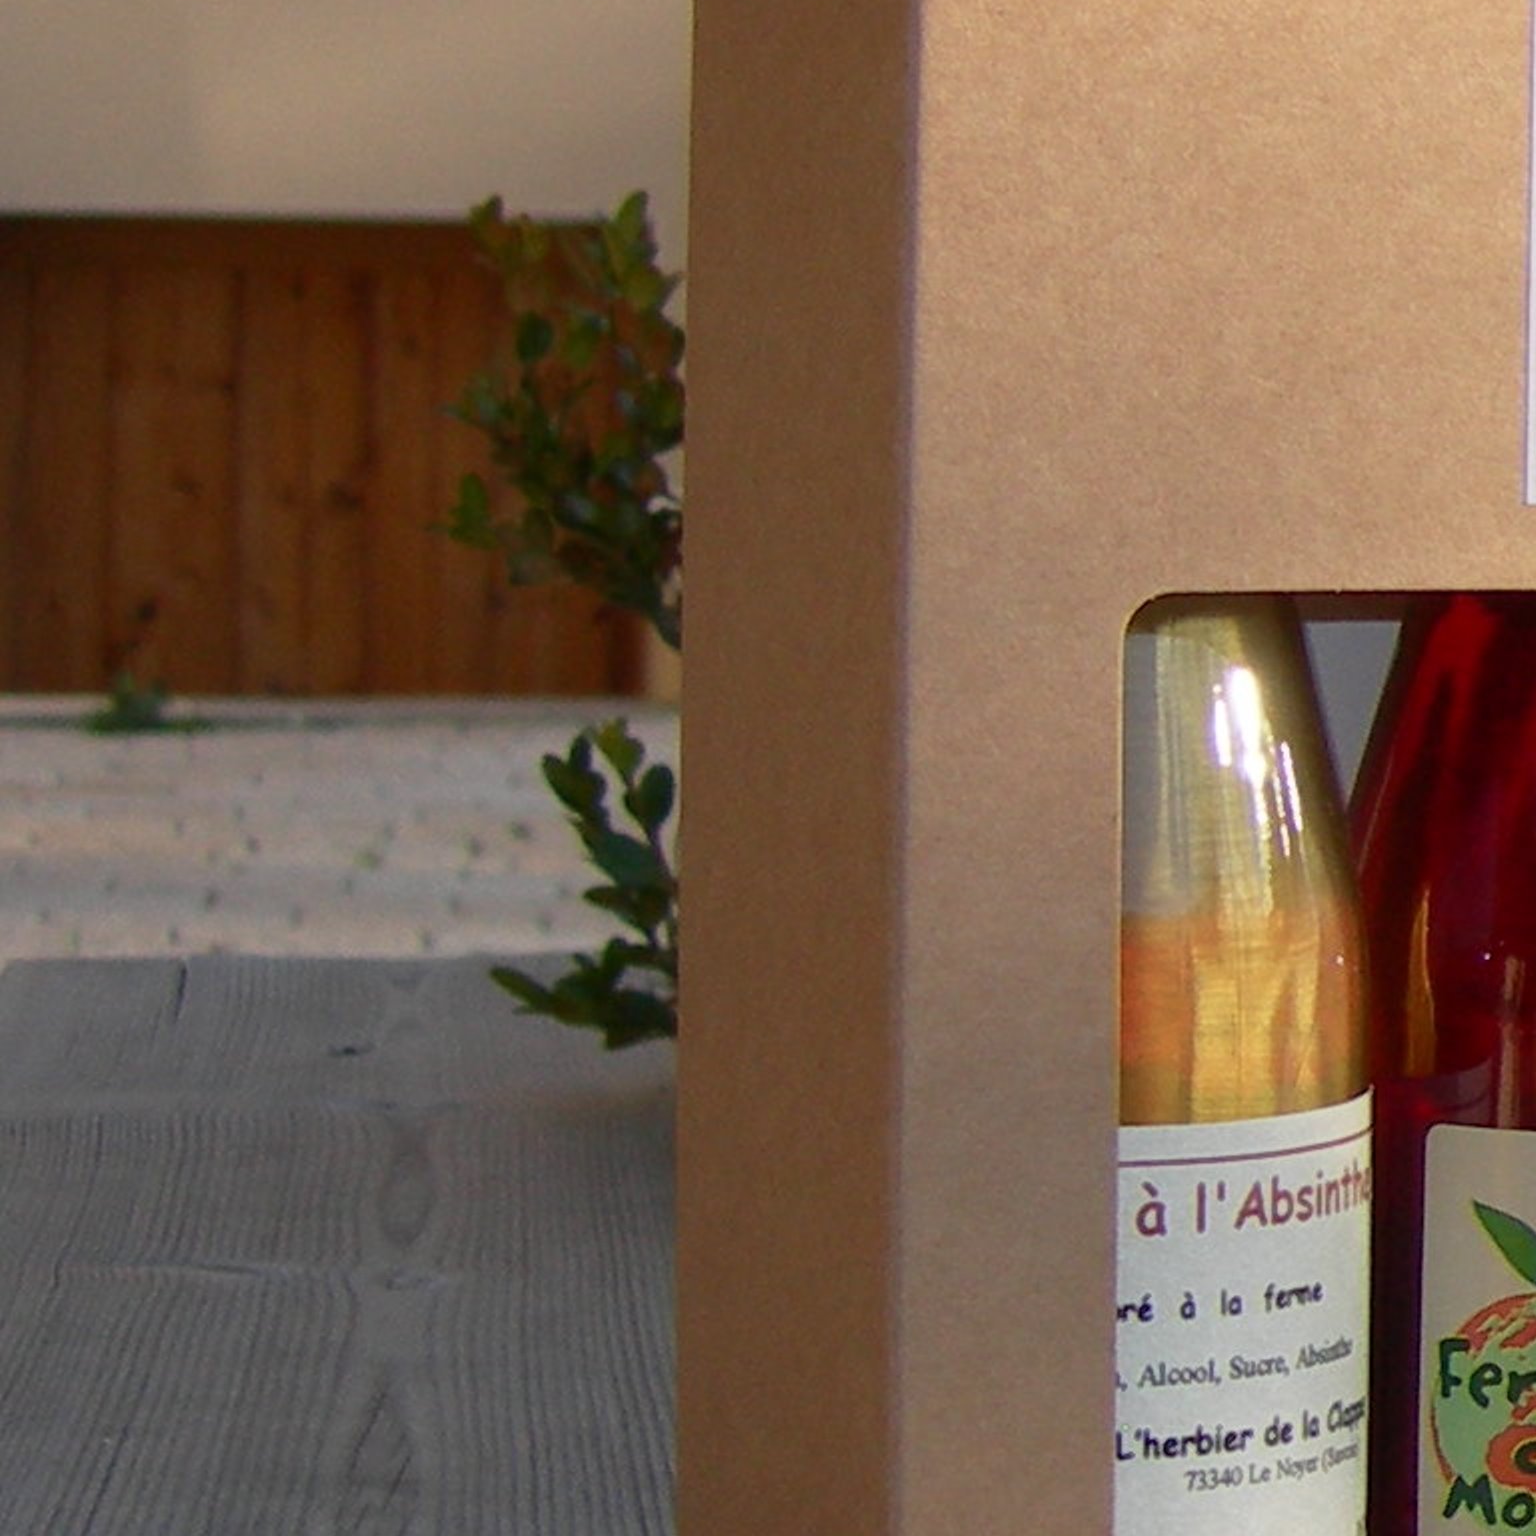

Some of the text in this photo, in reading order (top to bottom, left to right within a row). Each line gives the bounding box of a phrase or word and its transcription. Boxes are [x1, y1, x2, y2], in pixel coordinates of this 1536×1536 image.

[1135, 1181, 1167, 1237] à
[1180, 1291, 1196, 1320] à
[1221, 1289, 1242, 1317] la
[1264, 1281, 1323, 1313] ferme
[1138, 1359, 1221, 1389] Alcool,
[1116, 1424, 1254, 1461] L'herbier
[1264, 1416, 1294, 1447] de
[1302, 1410, 1320, 1440] la
[1184, 1465, 1243, 1492] 73340
[1248, 1461, 1271, 1485] Le
